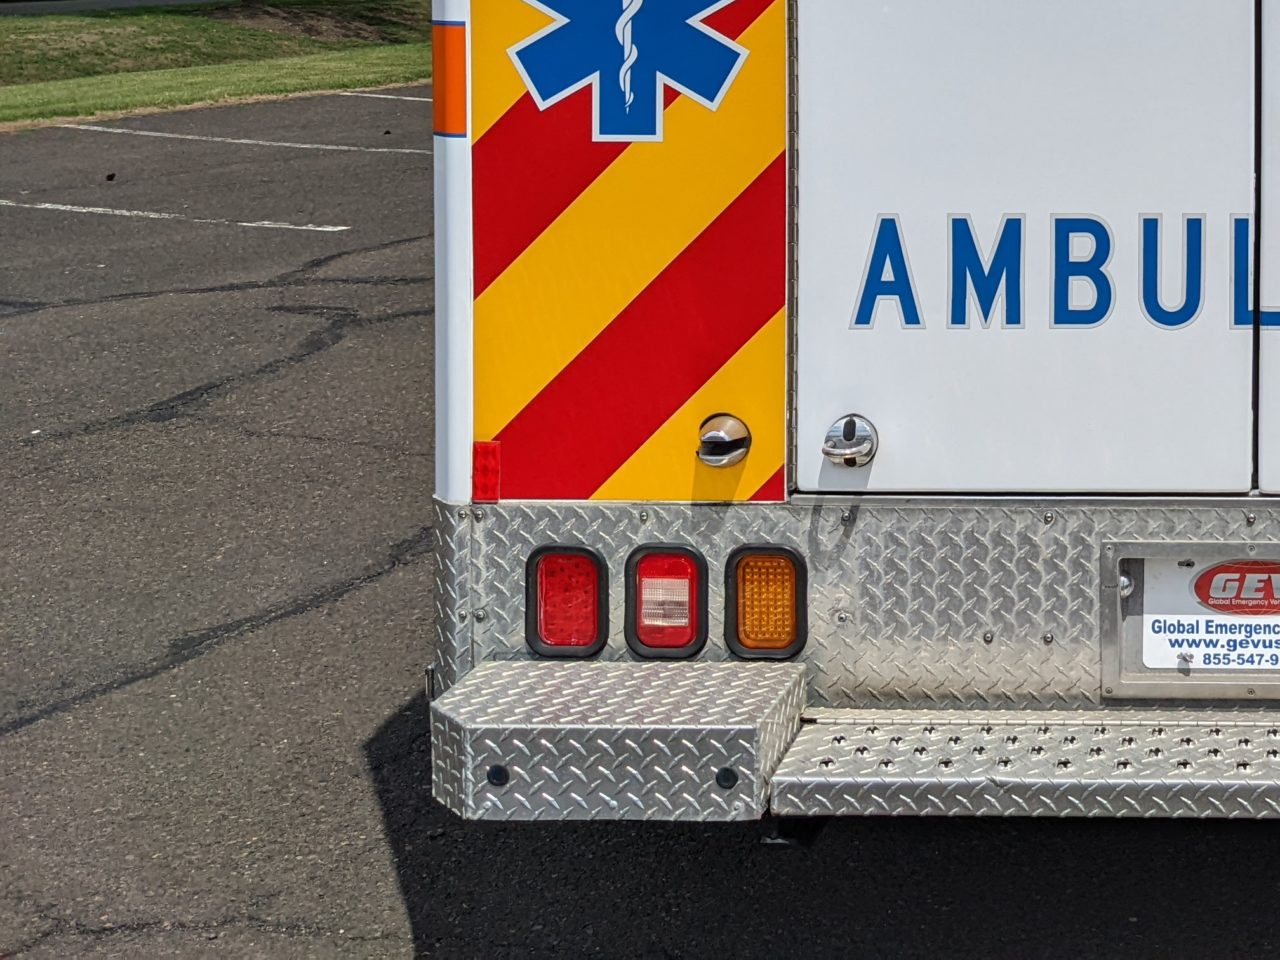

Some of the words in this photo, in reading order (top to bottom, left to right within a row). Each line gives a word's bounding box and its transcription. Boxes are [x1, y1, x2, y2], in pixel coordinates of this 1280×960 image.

[1208, 597, 1230, 605] Global
[1231, 598, 1268, 607] Emergency
[1151, 619, 1200, 635] Global
